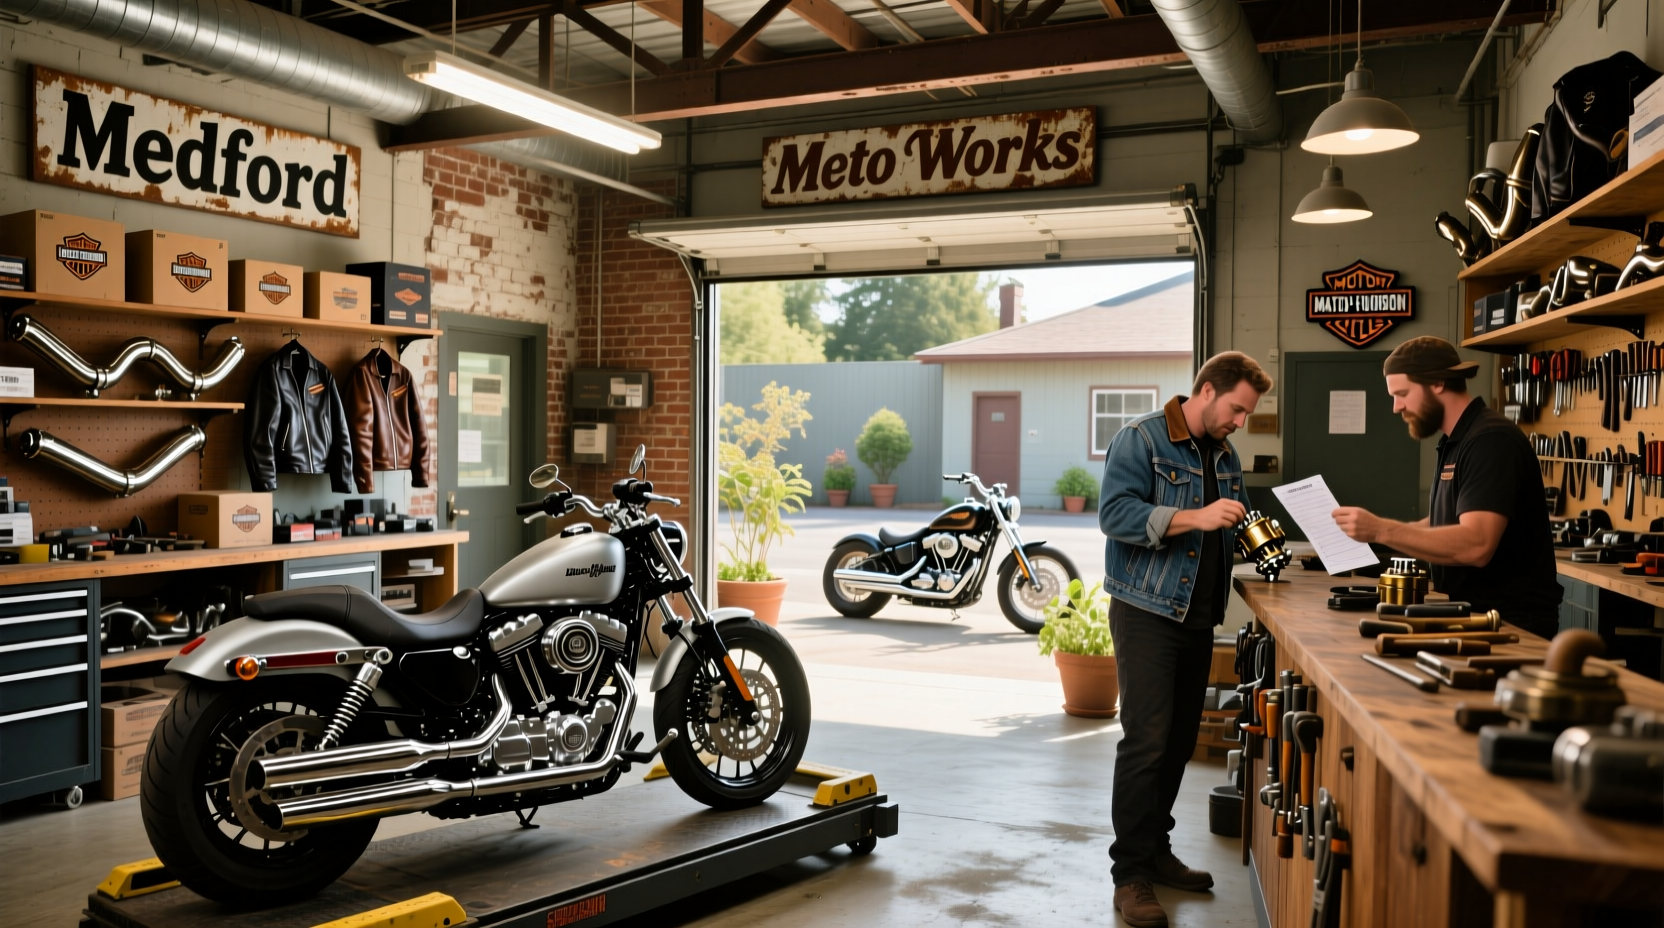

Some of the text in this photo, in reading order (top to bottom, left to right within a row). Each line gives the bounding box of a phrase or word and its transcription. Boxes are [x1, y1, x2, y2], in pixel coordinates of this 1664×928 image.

[57, 88, 348, 218] Medford
[770, 118, 1081, 195] Meto Works
